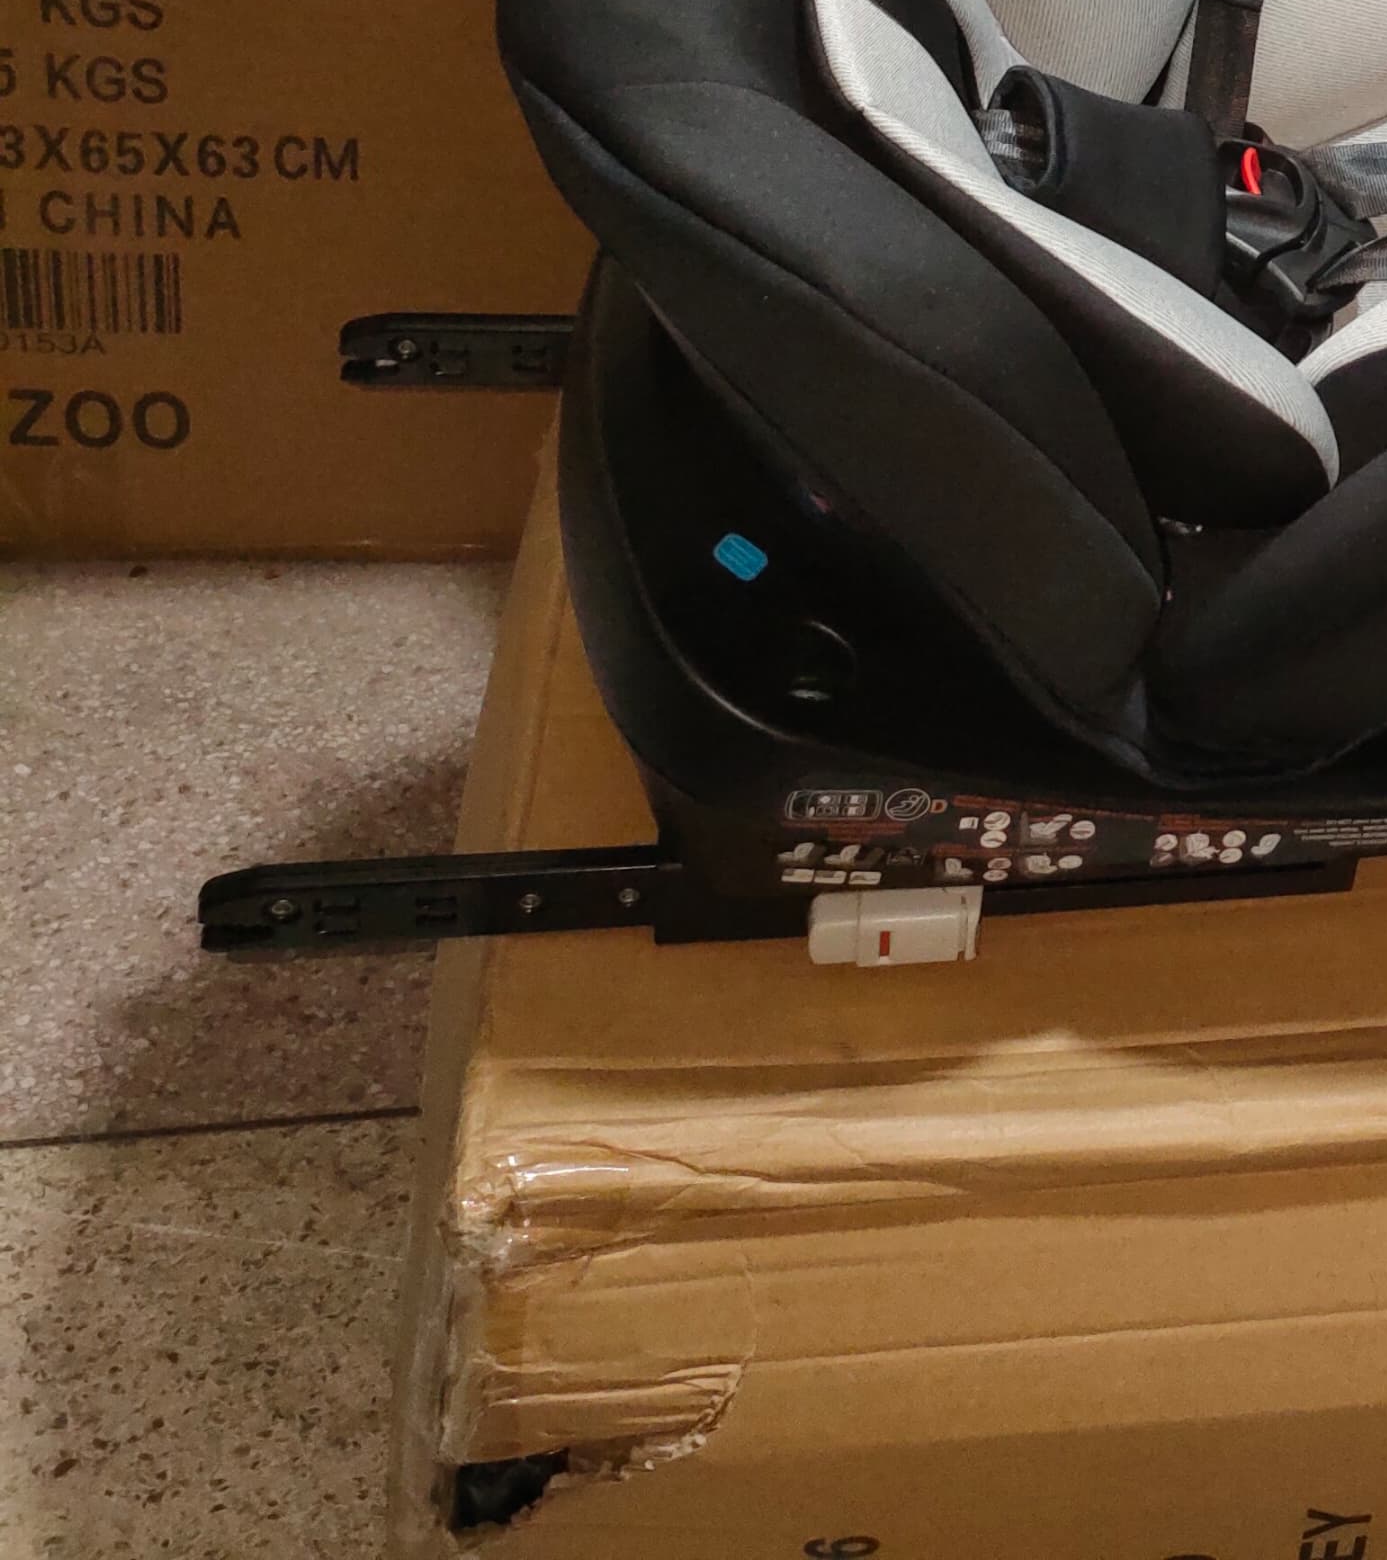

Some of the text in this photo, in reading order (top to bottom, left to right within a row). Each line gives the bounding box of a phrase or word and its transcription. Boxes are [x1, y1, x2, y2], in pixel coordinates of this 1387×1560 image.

[45, 52, 168, 103] KGS
[40, 191, 242, 240] CHINA
[8, 390, 190, 450] ZOO
